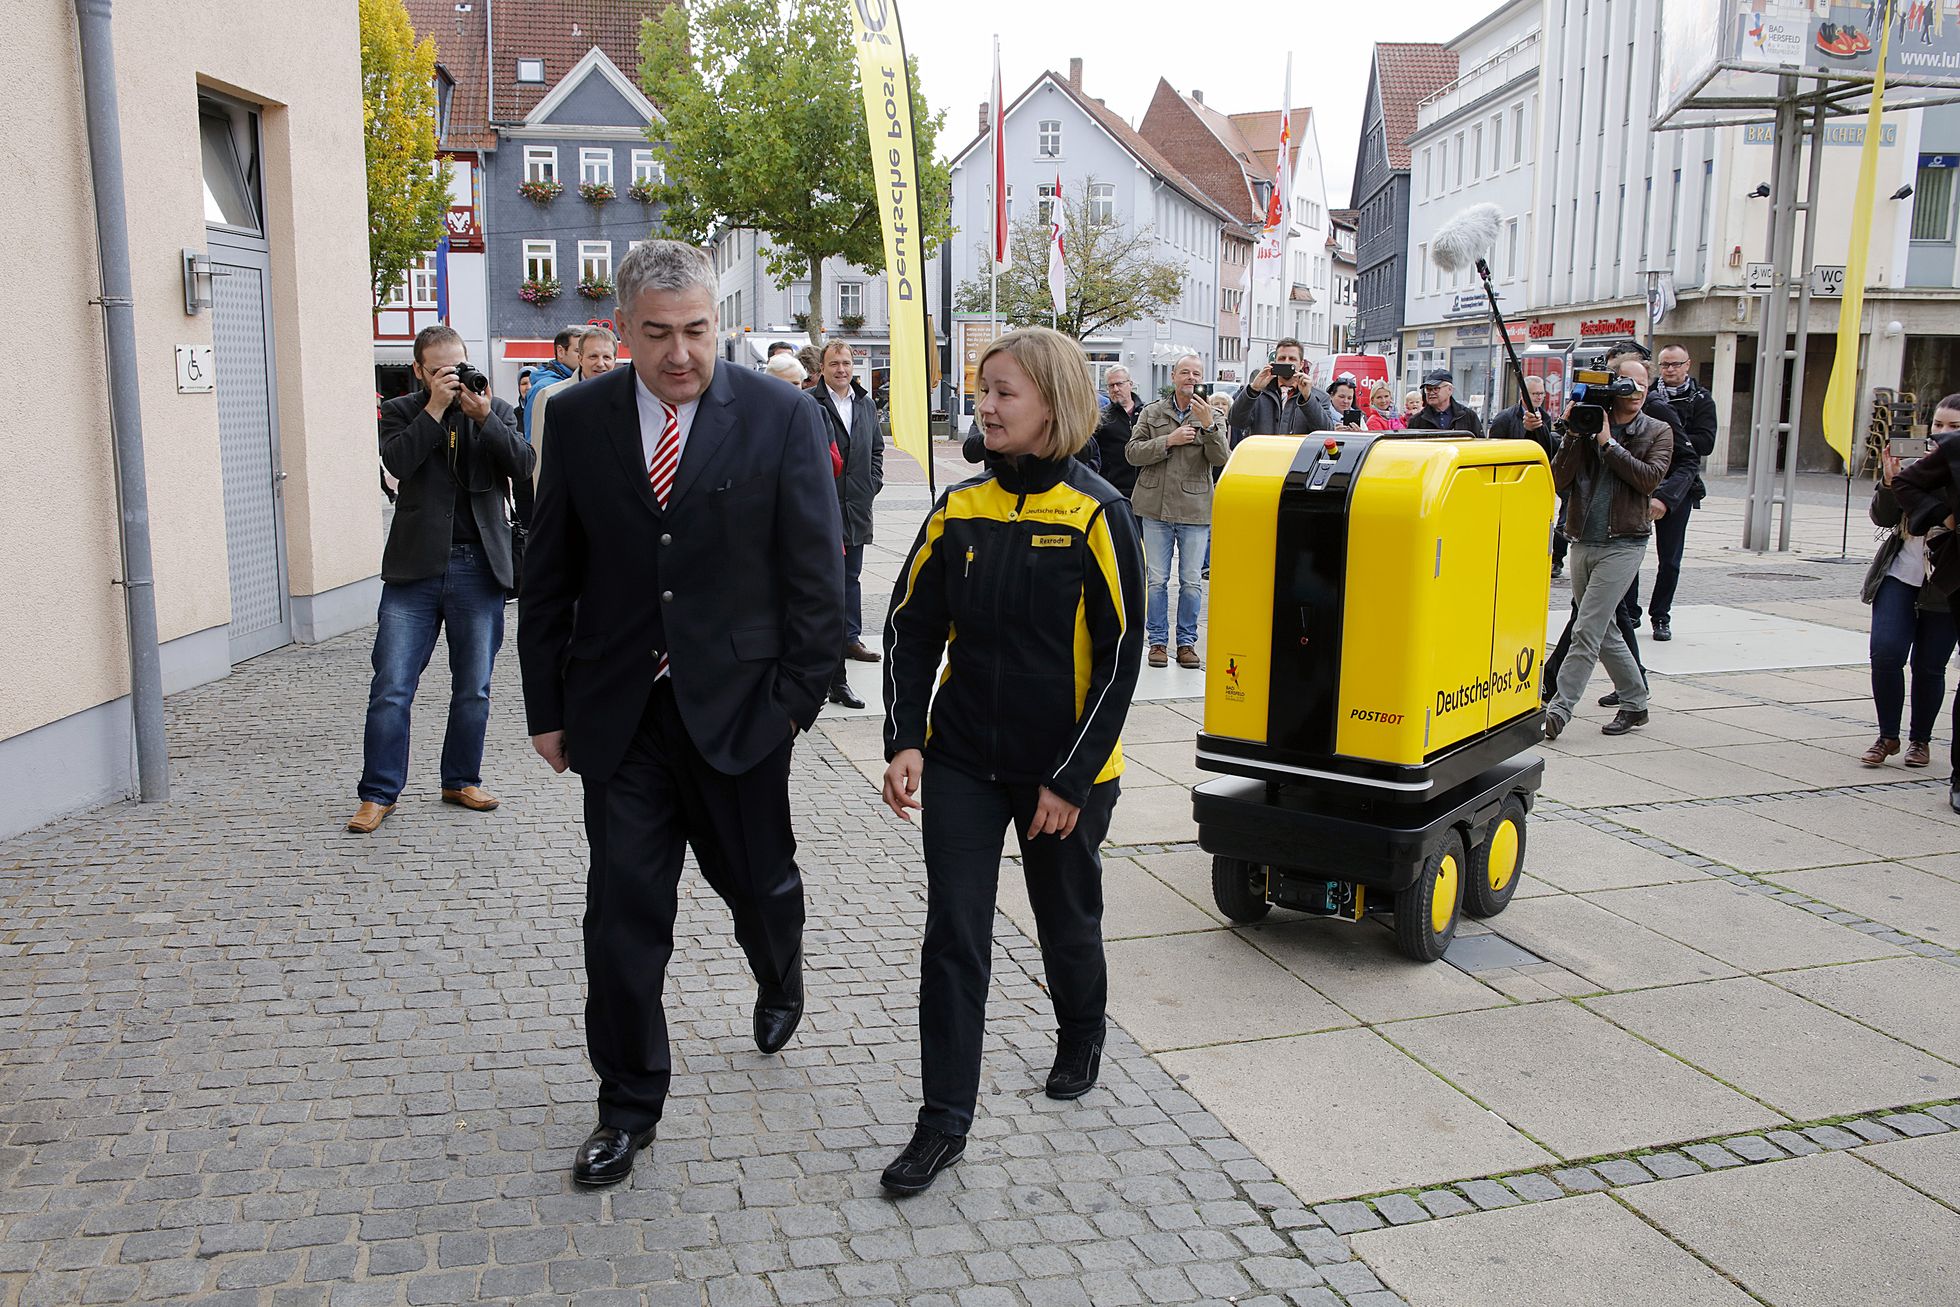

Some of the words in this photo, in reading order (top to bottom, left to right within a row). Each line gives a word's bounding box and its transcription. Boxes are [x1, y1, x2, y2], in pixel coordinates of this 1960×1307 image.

[1768, 24, 1784, 33] BAD
[1768, 33, 1801, 44] HERSFELD
[1760, 268, 1772, 278] WC
[1821, 270, 1843, 283] WC
[1039, 537, 1065, 545] Rexrodt
[1436, 675, 1489, 716] Deutsche
[1490, 668, 1513, 696] Post
[1350, 708, 1405, 725] POSTBOT
